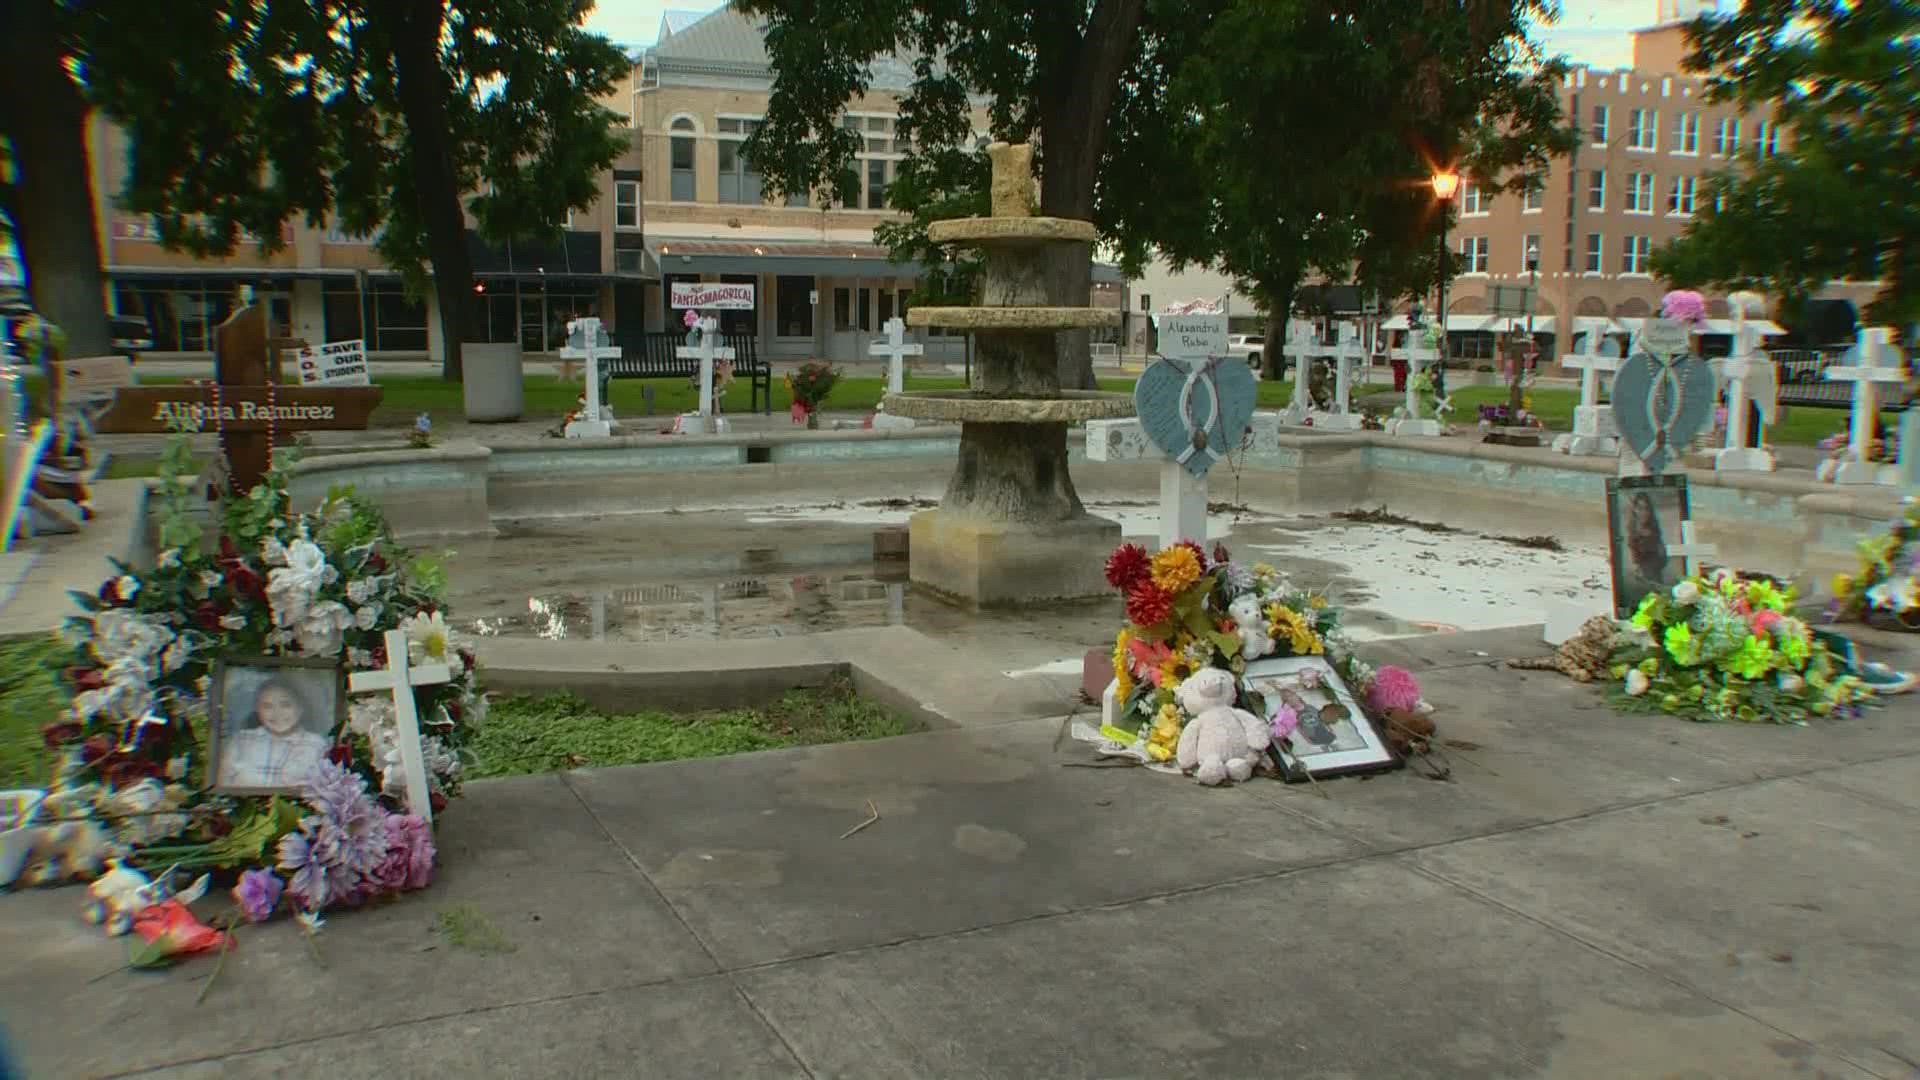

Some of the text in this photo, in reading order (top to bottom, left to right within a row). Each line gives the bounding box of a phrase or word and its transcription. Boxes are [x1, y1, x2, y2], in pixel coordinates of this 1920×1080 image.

[672, 287, 753, 305] FANTASMAGORICAL
[322, 342, 361, 355] SAVE
[335, 352, 363, 365] OUR
[325, 365, 366, 378] STUDENTS
[240, 401, 335, 420] Ramirez
